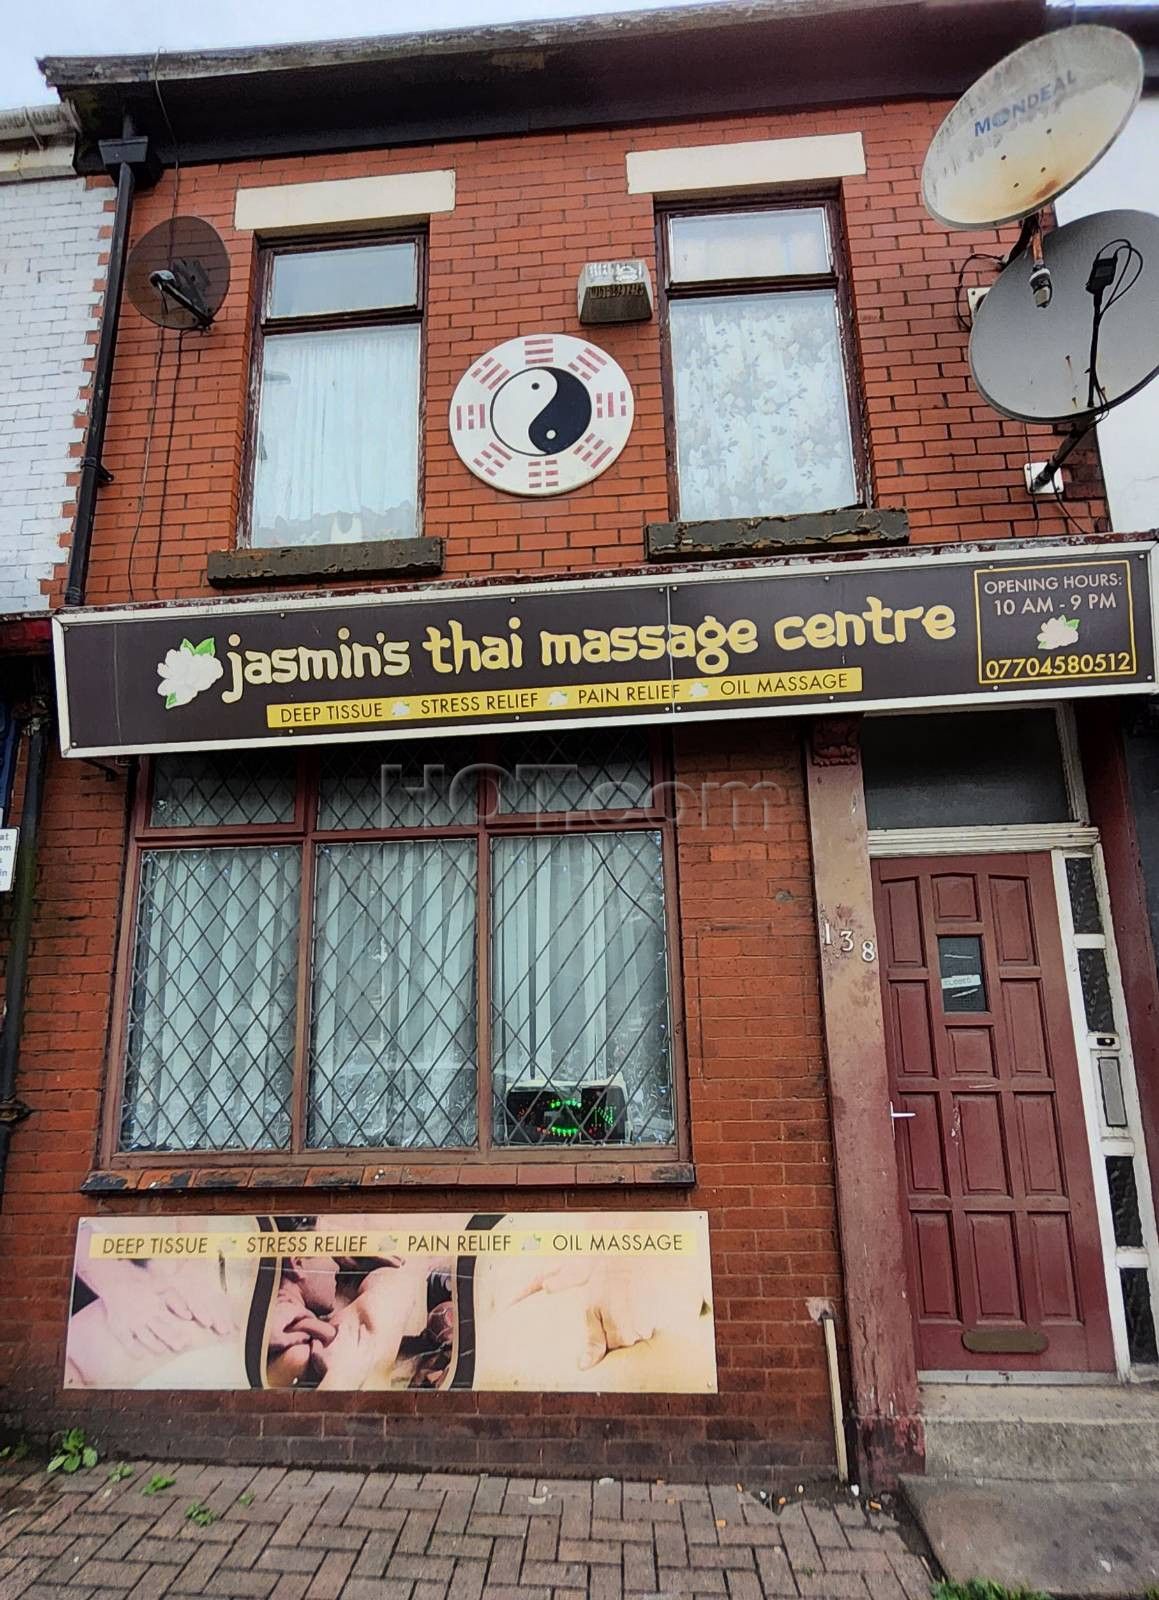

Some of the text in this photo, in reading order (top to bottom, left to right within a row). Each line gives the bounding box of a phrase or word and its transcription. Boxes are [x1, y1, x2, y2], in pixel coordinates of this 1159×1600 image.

[974, 70, 1077, 137] MONDEAL
[984, 573, 1123, 595] OPENING HOURS:
[994, 599, 1016, 616] 10
[1021, 597, 1054, 614] AM
[1070, 594, 1082, 611] 9
[1088, 592, 1117, 610] PM
[221, 596, 956, 704] jasmin's thai massage centre
[985, 652, 1131, 679] 07704580512
[578, 684, 681, 705] PAIN RELIEF
[720, 672, 848, 696] OIL MASSAGE
[280, 702, 383, 723] DEEP TISSUE
[420, 692, 539, 715] STRESS RELIEF
[823, 921, 876, 962] 138
[102, 1237, 209, 1254] DEEP TISSUE
[246, 1235, 368, 1253] STRESS RELIEF
[407, 1234, 512, 1252] PAIN RELIEF
[552, 1233, 683, 1251] OIL MASSAGE
